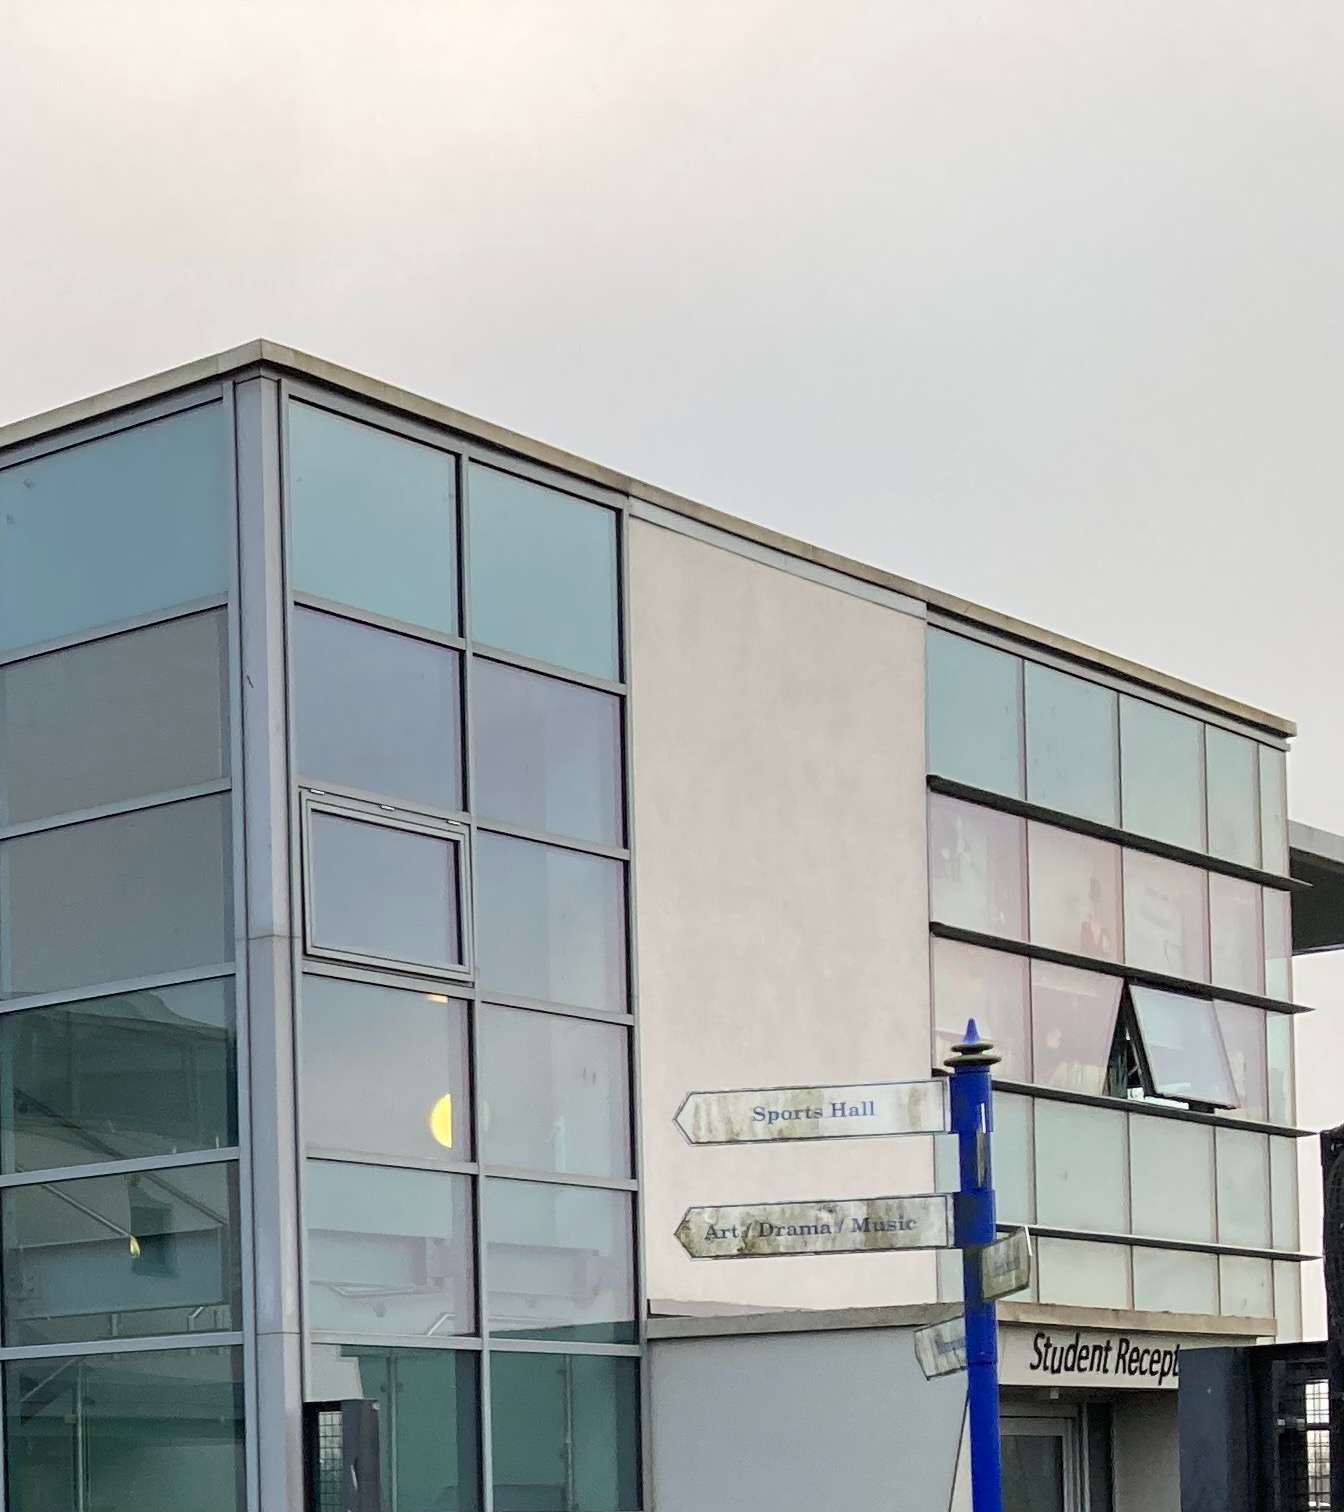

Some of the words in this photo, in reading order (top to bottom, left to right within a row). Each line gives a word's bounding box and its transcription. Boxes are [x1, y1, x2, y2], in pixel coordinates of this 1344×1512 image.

[752, 1105, 823, 1125] Sports
[830, 1100, 875, 1119] Hall
[703, 1224, 739, 1241] Art
[758, 1221, 833, 1239] Drama
[851, 1215, 917, 1233] Music
[1029, 1331, 1113, 1375] Student
[1115, 1337, 1181, 1386] Recept
